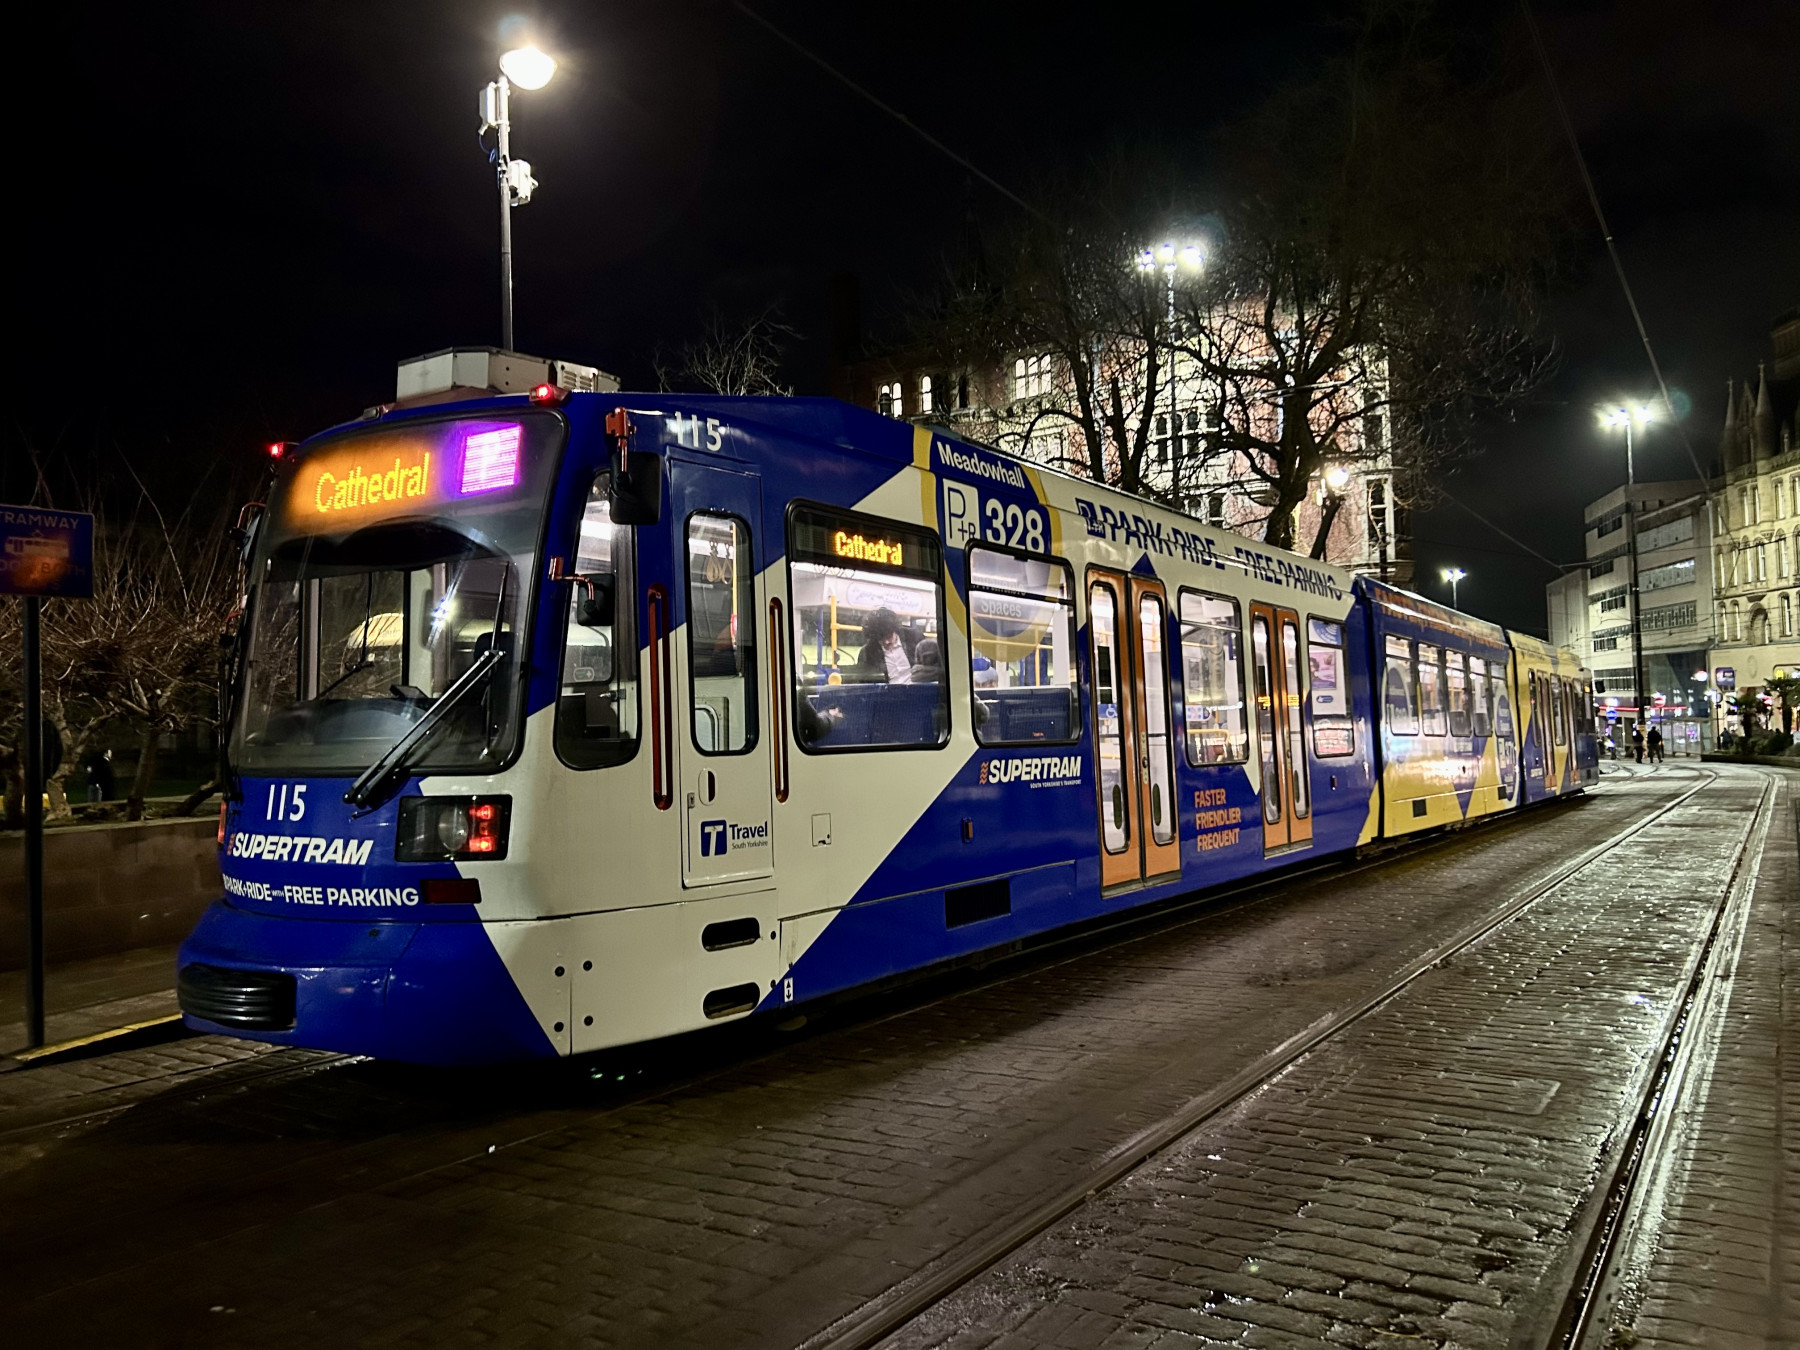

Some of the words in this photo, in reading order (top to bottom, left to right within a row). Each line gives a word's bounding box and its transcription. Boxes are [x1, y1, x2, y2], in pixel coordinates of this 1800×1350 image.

[675, 411, 722, 451] 115
[937, 441, 1025, 489] Meadowhall
[315, 452, 430, 512] Cathedral
[985, 498, 1044, 554] 328
[834, 531, 903, 566] Cathedral
[1234, 546, 1282, 585] FREE
[1277, 559, 1342, 601] PARKING
[981, 599, 1022, 618] Spaces
[988, 756, 1081, 784] SUPERTRAM
[266, 784, 307, 822] 115
[1194, 788, 1226, 808] FASTER
[729, 821, 768, 840] Travel
[1195, 807, 1242, 830] FRIENDLIER
[232, 832, 374, 866] SUPERTRAM
[731, 842, 746, 850] South
[747, 840, 768, 849] Yorkshire
[1196, 828, 1240, 851] FREQUENT
[284, 885, 324, 905] FREE
[327, 888, 419, 906] PARKING
